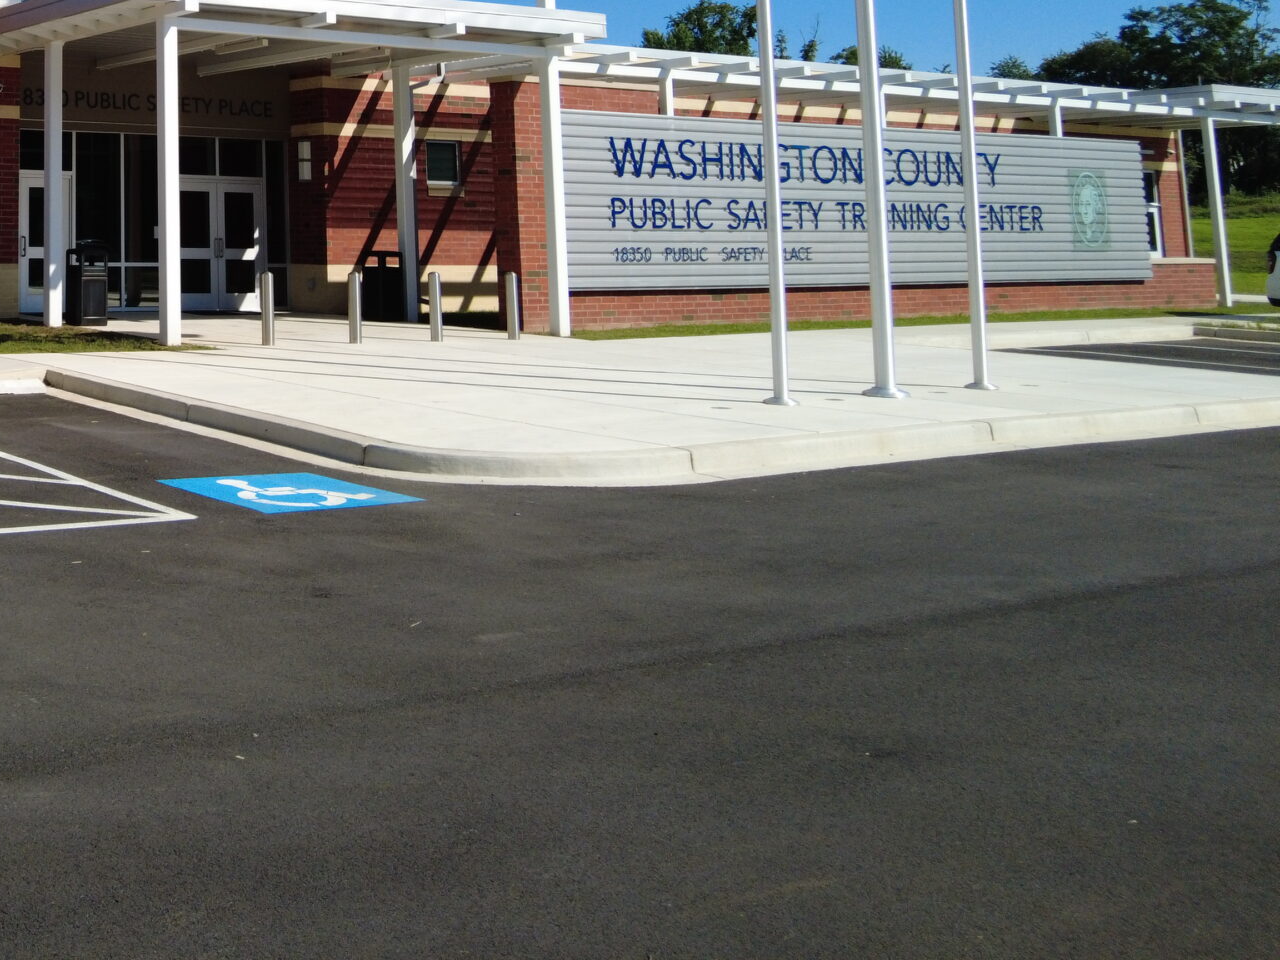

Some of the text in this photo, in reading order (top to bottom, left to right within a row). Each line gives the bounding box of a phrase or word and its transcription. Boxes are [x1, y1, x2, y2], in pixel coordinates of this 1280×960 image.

[74, 90, 140, 111] PUBLIC
[146, 94, 212, 114] SETY
[218, 99, 273, 118] PLACE
[882, 147, 1001, 188] OUNY
[610, 196, 714, 230] PUBLIC
[835, 201, 950, 231] TRNING
[613, 246, 813, 263] 18350 PUBLIC SAFETY LACE
